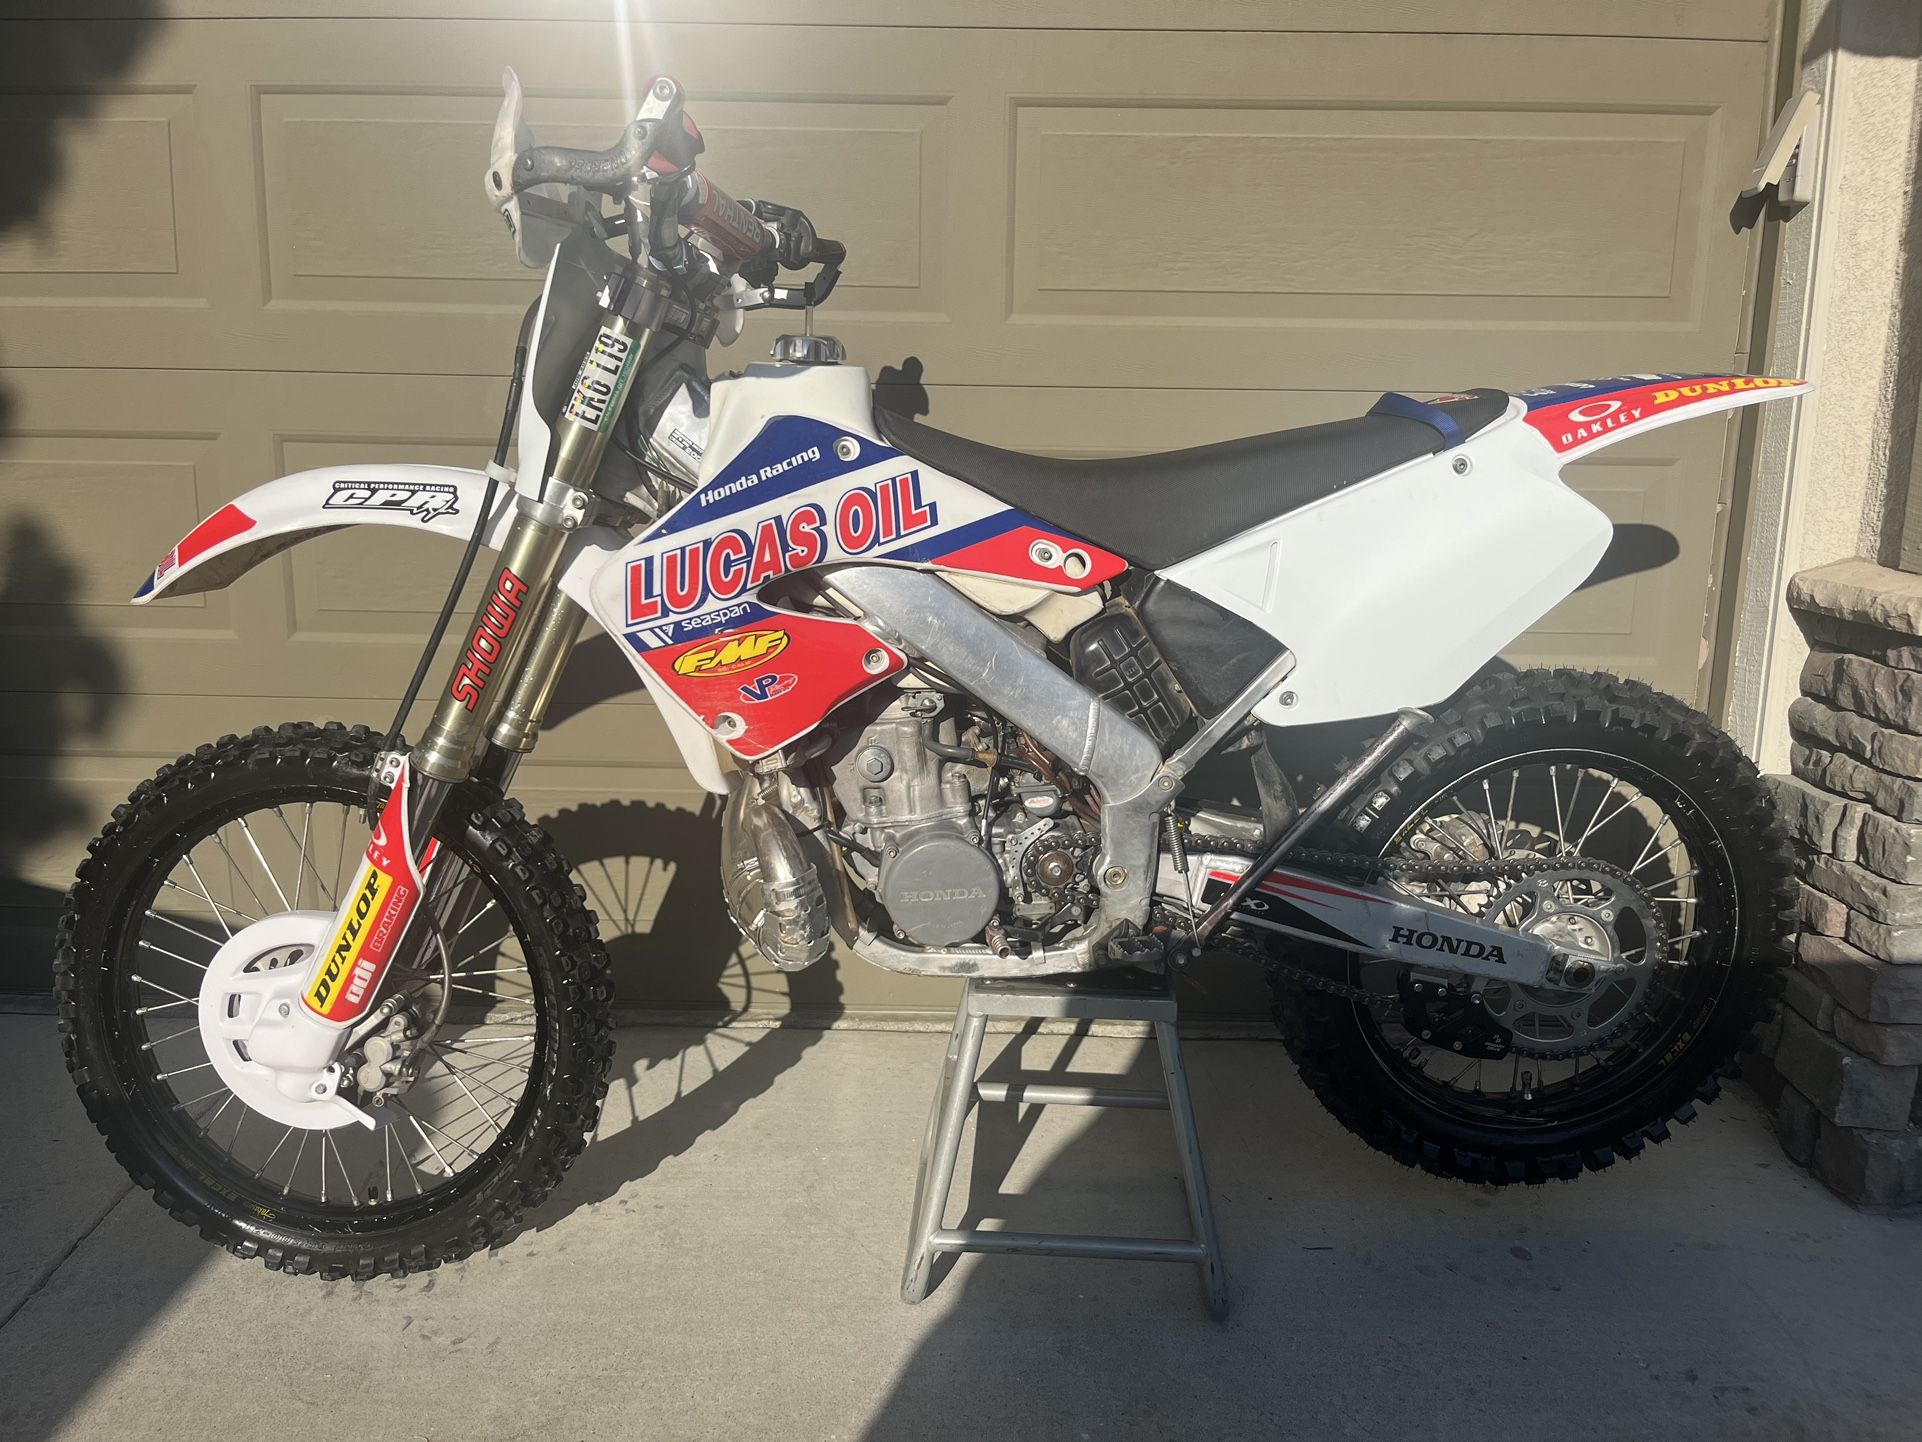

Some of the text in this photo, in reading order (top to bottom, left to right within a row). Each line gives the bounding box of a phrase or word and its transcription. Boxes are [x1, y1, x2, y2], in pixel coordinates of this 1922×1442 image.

[589, 332, 629, 376] L19
[1560, 407, 1642, 445] OAKLEY
[370, 483, 424, 491] PERFORMANCE
[425, 485, 455, 493] RACING
[700, 446, 821, 508] Honda Racing
[328, 488, 456, 510] CPR
[625, 469, 938, 627] LUCAS OIL
[681, 603, 751, 632] seaspan
[451, 567, 529, 713] SHOWA
[677, 629, 785, 675] FMF
[738, 673, 780, 702] VP
[368, 841, 391, 867] LEY
[899, 887, 987, 903] HONDA
[313, 868, 380, 1009] DUNLOP
[371, 886, 408, 951] BRAKING
[1389, 925, 1508, 965] HONDA
[345, 958, 377, 1004] odi
